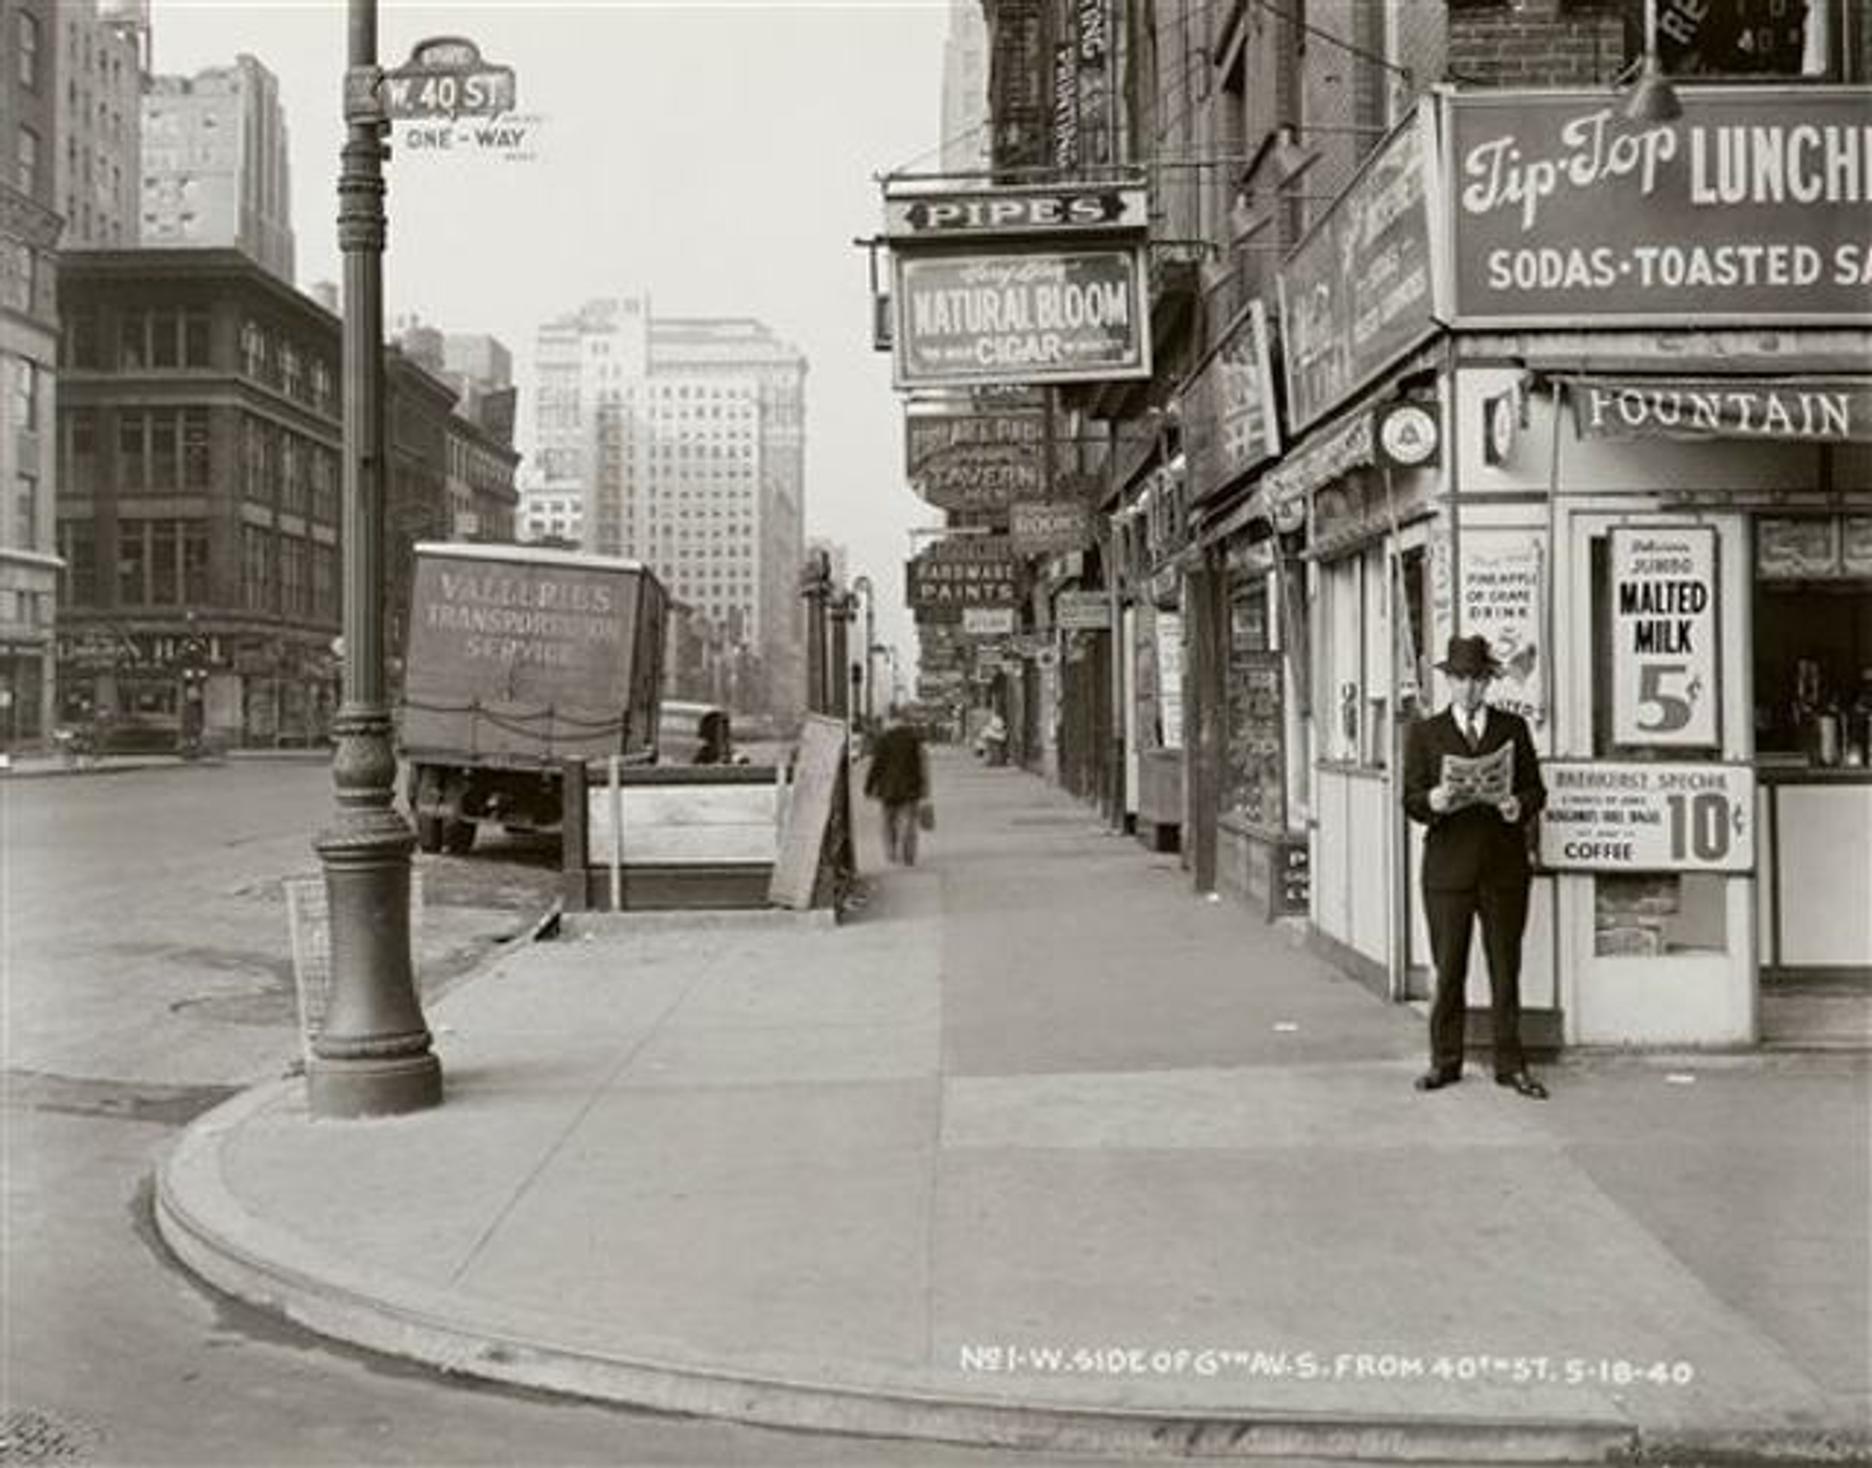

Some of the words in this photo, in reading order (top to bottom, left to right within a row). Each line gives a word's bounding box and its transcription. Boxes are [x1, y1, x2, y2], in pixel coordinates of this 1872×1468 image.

[420, 76, 456, 109] 40
[464, 75, 507, 108] ST
[926, 197, 1105, 229] PIPES
[912, 284, 1033, 338] NATURAL
[1035, 281, 1128, 329] BLOOM
[976, 333, 1064, 364] CIGAR
[1587, 389, 1851, 437] FOUNTAIN
[920, 583, 1014, 602] PAINTS
[1620, 582, 1709, 616] MALTED
[1469, 606, 1529, 619] DRINK
[1635, 620, 1693, 655] MILK
[1563, 842, 1634, 862] COFFEE
